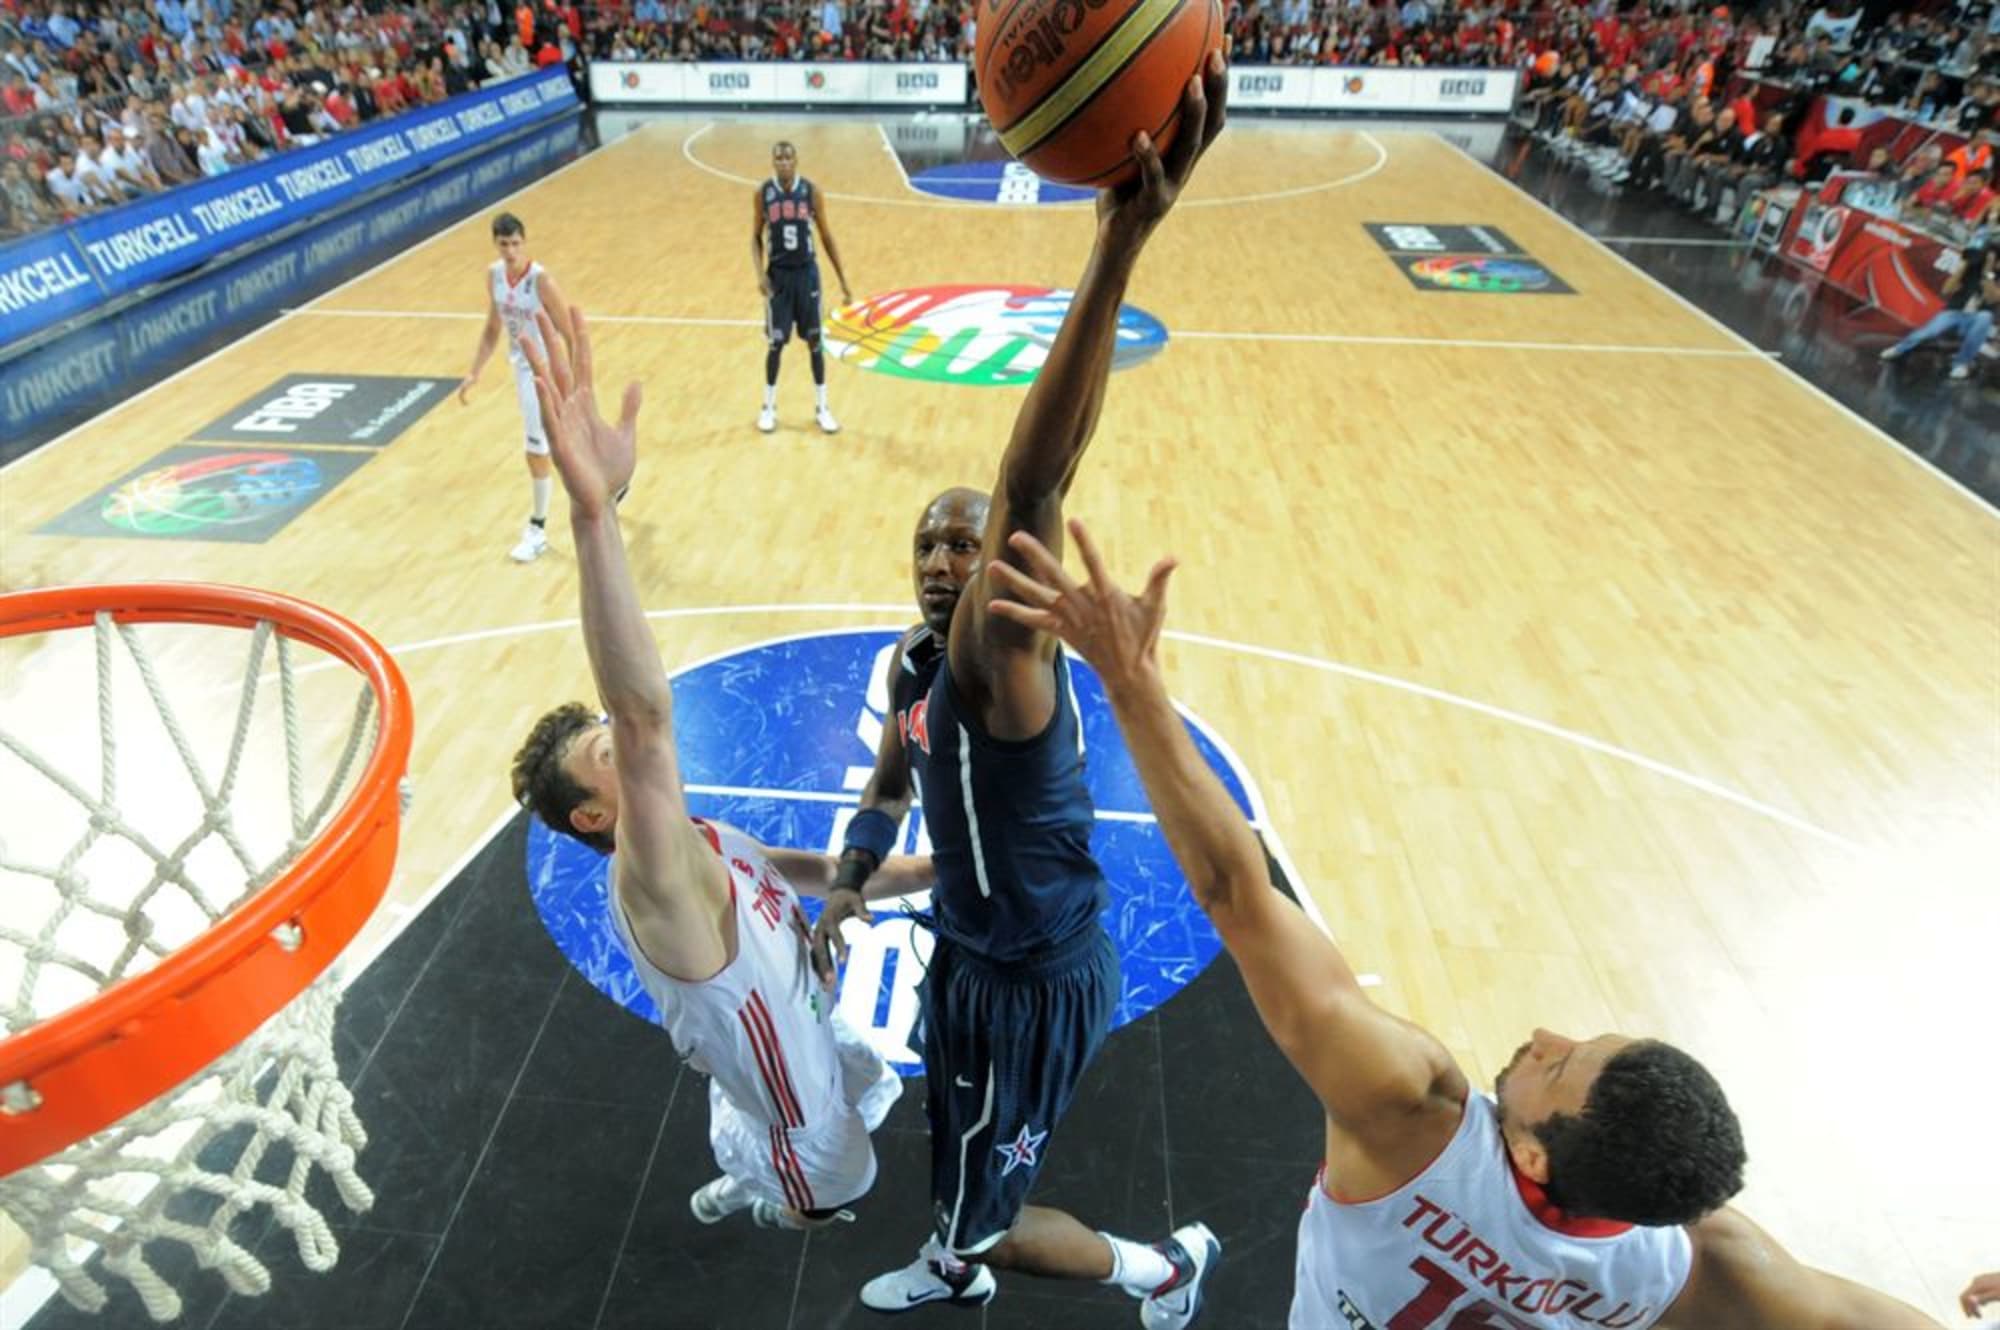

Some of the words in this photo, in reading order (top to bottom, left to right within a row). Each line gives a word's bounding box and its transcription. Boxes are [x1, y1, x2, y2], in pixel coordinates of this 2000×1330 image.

[993, 0, 1106, 103] olten
[87, 213, 198, 275] TURKCELL
[192, 182, 283, 234] TURKCELL
[276, 156, 352, 202] TURKCELL
[347, 132, 411, 174] TURKCELL
[783, 225, 798, 250] 5
[232, 382, 357, 432] FIBA
